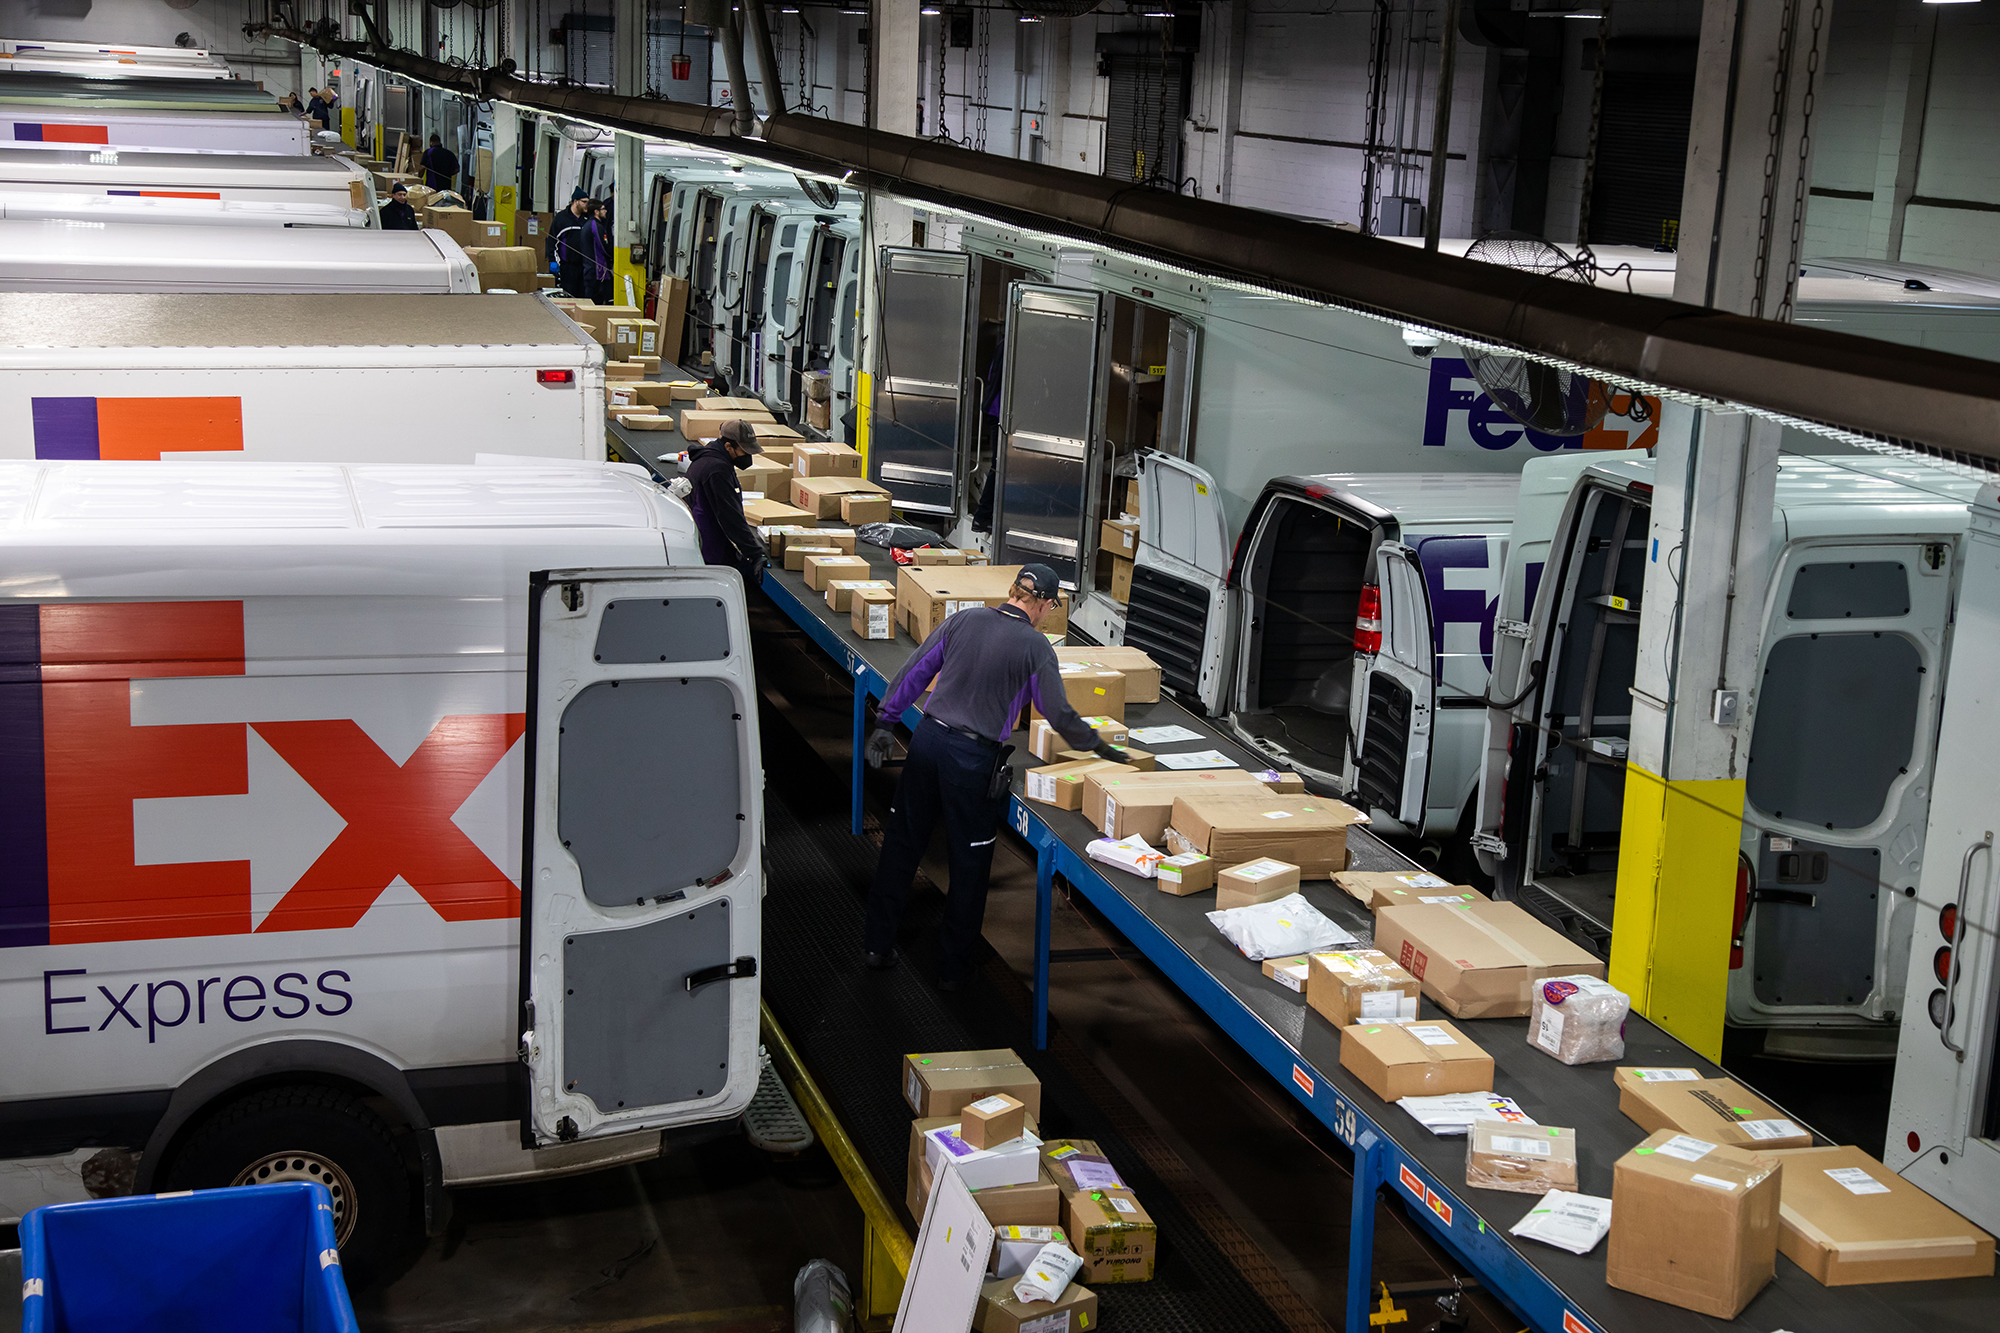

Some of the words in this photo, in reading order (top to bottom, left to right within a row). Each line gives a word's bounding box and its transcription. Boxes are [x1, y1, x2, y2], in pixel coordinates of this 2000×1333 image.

[1016, 805, 1029, 838] 58
[43, 968, 354, 1043] Express
[1334, 1098, 1357, 1146] 59
[1486, 1097, 1526, 1124] FdEx
